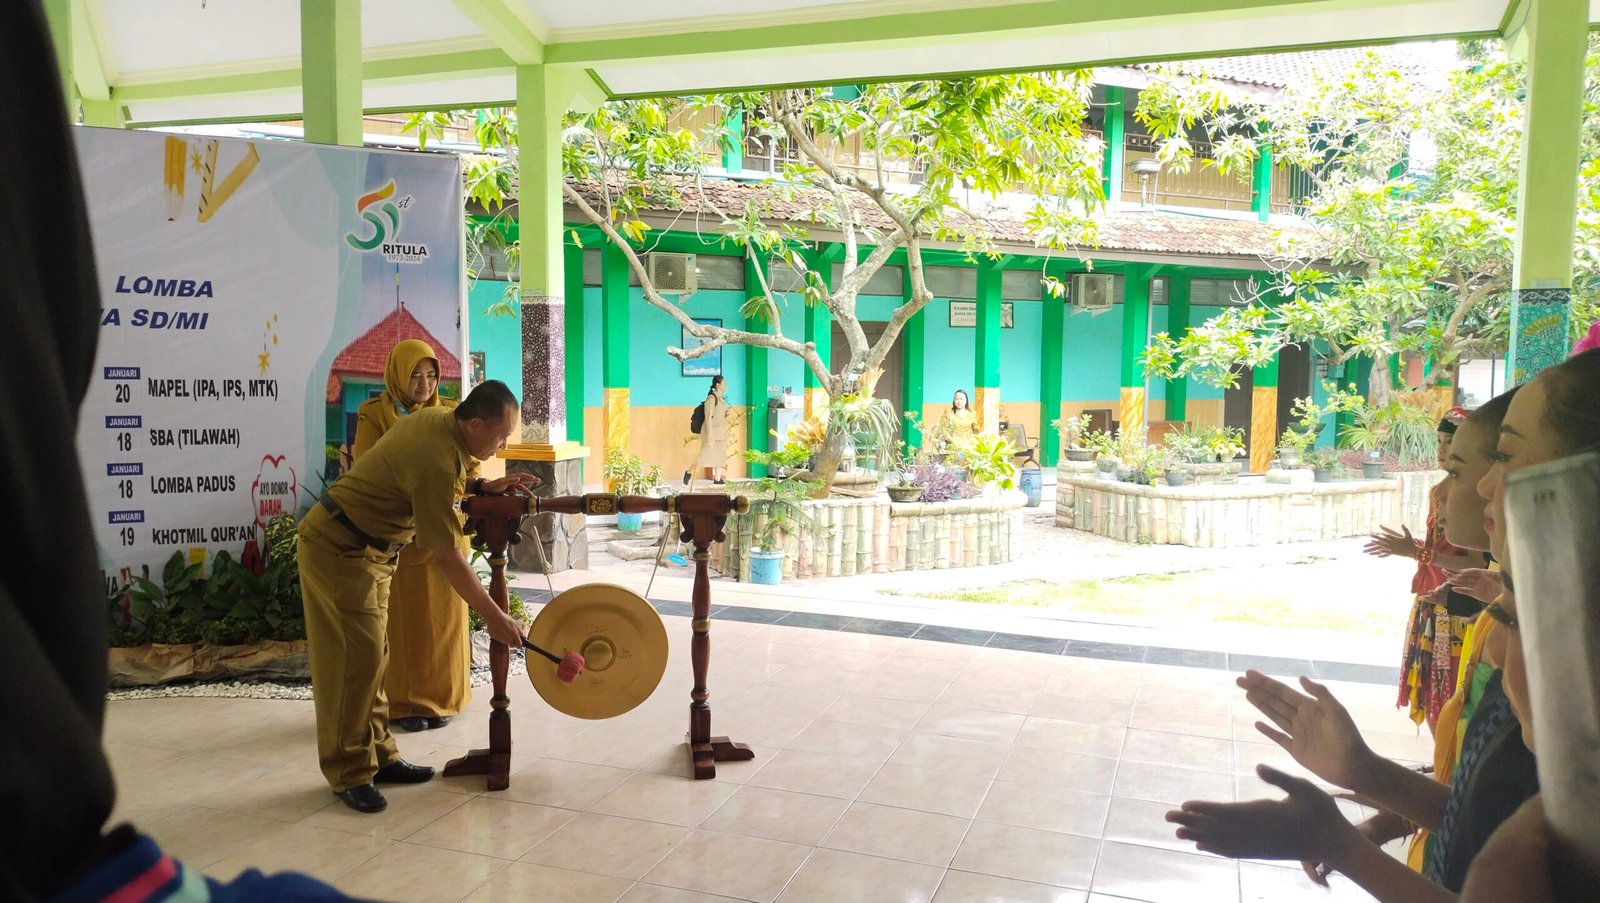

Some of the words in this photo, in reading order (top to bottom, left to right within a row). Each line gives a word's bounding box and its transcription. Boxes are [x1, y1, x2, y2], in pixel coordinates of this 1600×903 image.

[382, 244, 428, 256] RITULA
[115, 275, 214, 298] LOMBA
[131, 308, 209, 330] SD/MI
[108, 369, 137, 378] JANUARI
[115, 383, 131, 403] 20
[148, 377, 190, 398] MAPEL
[193, 378, 220, 402] (IPA,
[223, 379, 246, 401] IPS,
[249, 379, 279, 402] MTK)
[109, 418, 139, 427] JANUARI
[117, 432, 132, 452] 18
[150, 428, 174, 447] SBA
[178, 428, 240, 449] (TILAWAH)
[111, 464, 140, 474] JANUARI
[118, 479, 133, 499] 18
[151, 476, 193, 494] LOMBA
[196, 475, 236, 493] PADUS
[260, 482, 269, 495] AYO
[271, 481, 289, 495] DONOR
[112, 512, 141, 522] JANUARI
[260, 499, 282, 516] DARAH
[120, 527, 135, 546] 19
[152, 528, 208, 545] KHOTMIL
[211, 525, 256, 543] QUR'AN
